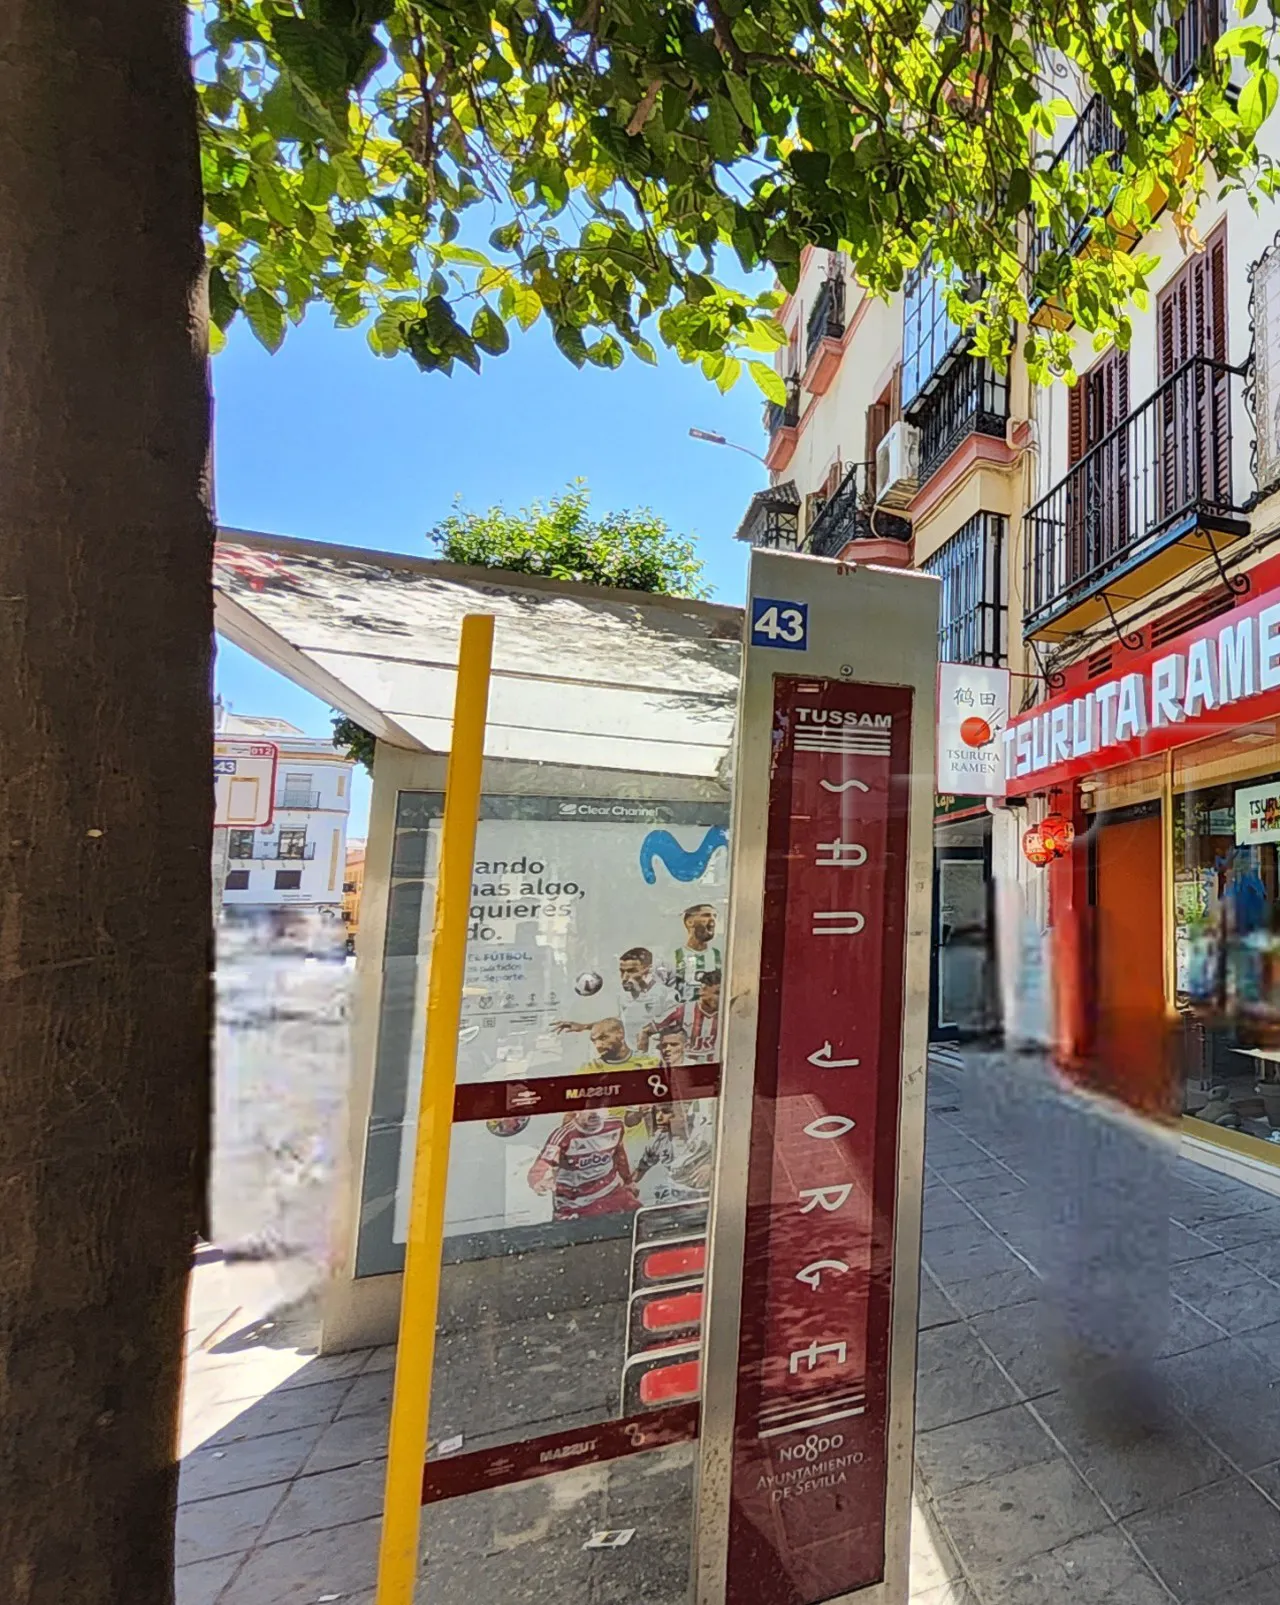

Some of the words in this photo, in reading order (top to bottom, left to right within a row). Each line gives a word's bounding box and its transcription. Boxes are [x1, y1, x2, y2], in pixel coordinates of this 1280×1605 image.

[754, 606, 804, 642] 43
[795, 707, 892, 728] TUSSAM
[1002, 672, 1149, 780] TSURUTA
[946, 749, 1001, 763] TSURUTA
[950, 762, 997, 774] RAMEN
[578, 804, 611, 815] Clear
[611, 805, 659, 817] Channel
[475, 856, 545, 875] ando
[520, 878, 586, 901] algo,
[469, 899, 572, 925] quieres
[756, 1452, 864, 1490] AYUNTAMIENTO
[771, 1487, 792, 1502] DE
[795, 1471, 847, 1496] SEVILLA
